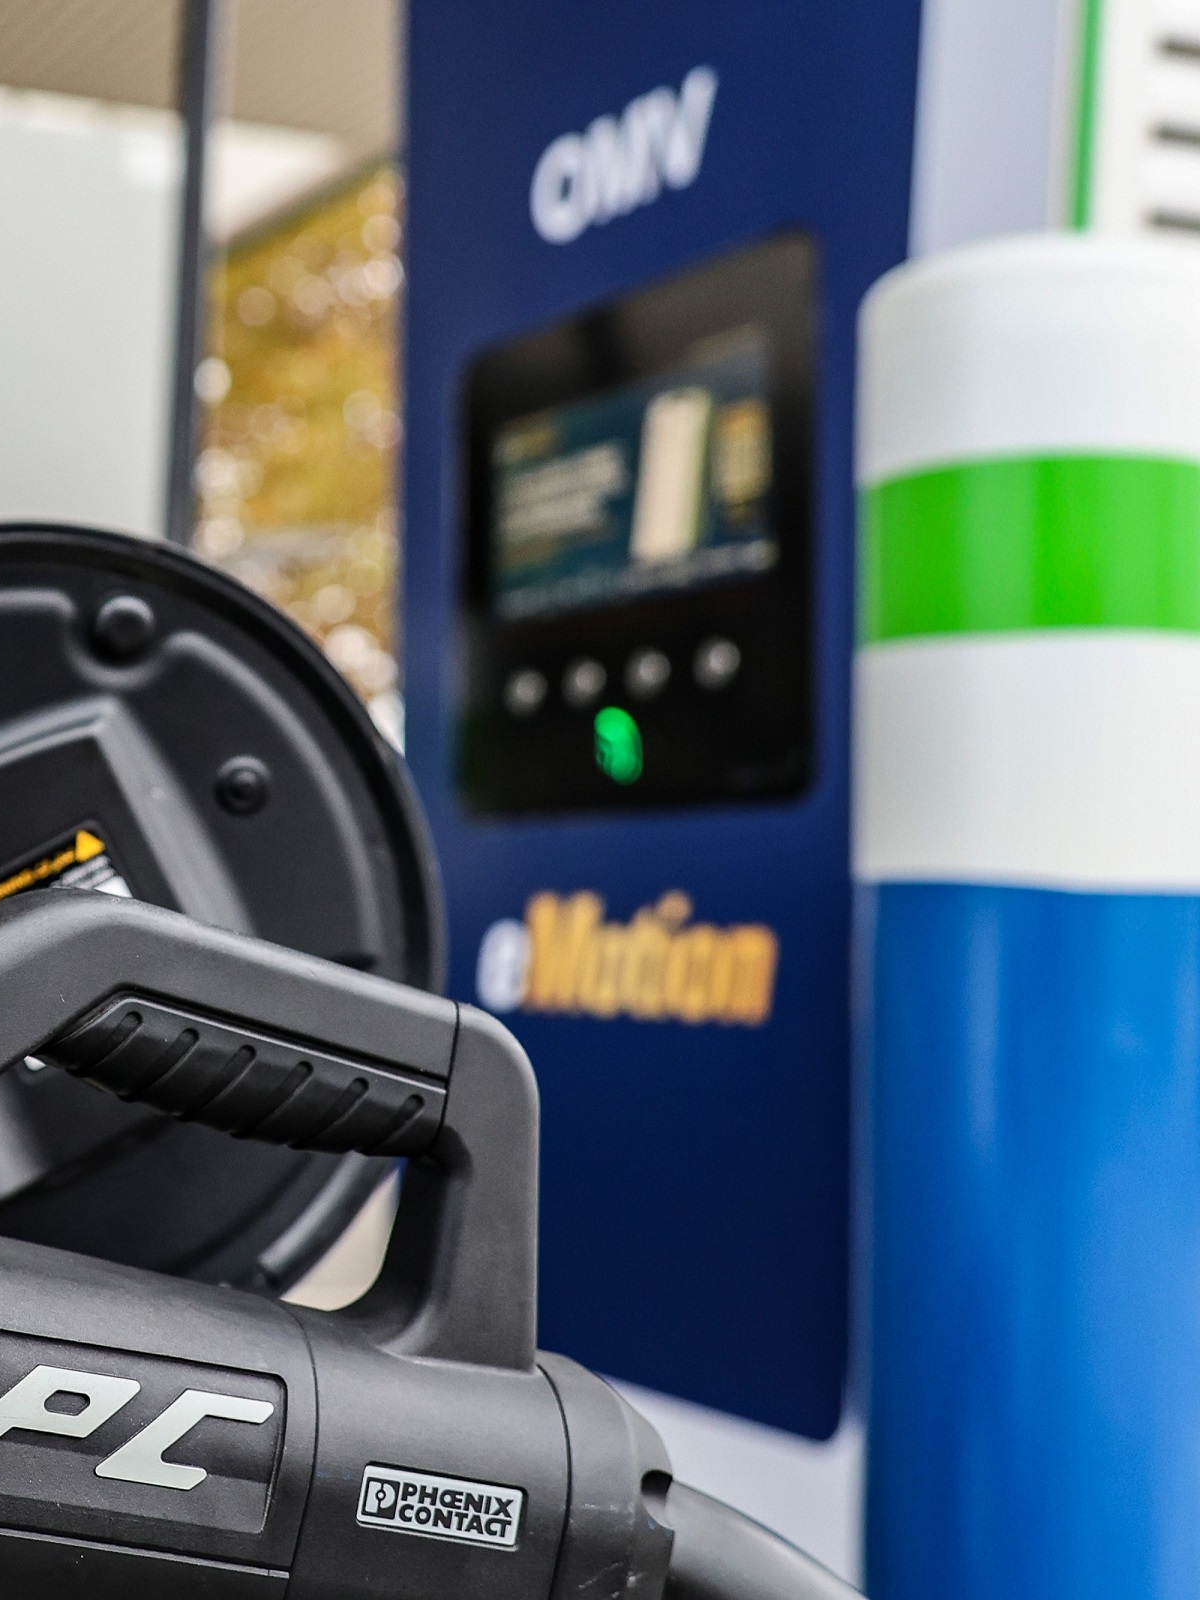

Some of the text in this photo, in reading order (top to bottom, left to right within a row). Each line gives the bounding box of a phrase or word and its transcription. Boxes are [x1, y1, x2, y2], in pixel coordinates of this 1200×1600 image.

[530, 66, 717, 243] OMV
[477, 890, 780, 1027] eMotion
[399, 1504, 512, 1538] CONTACT
